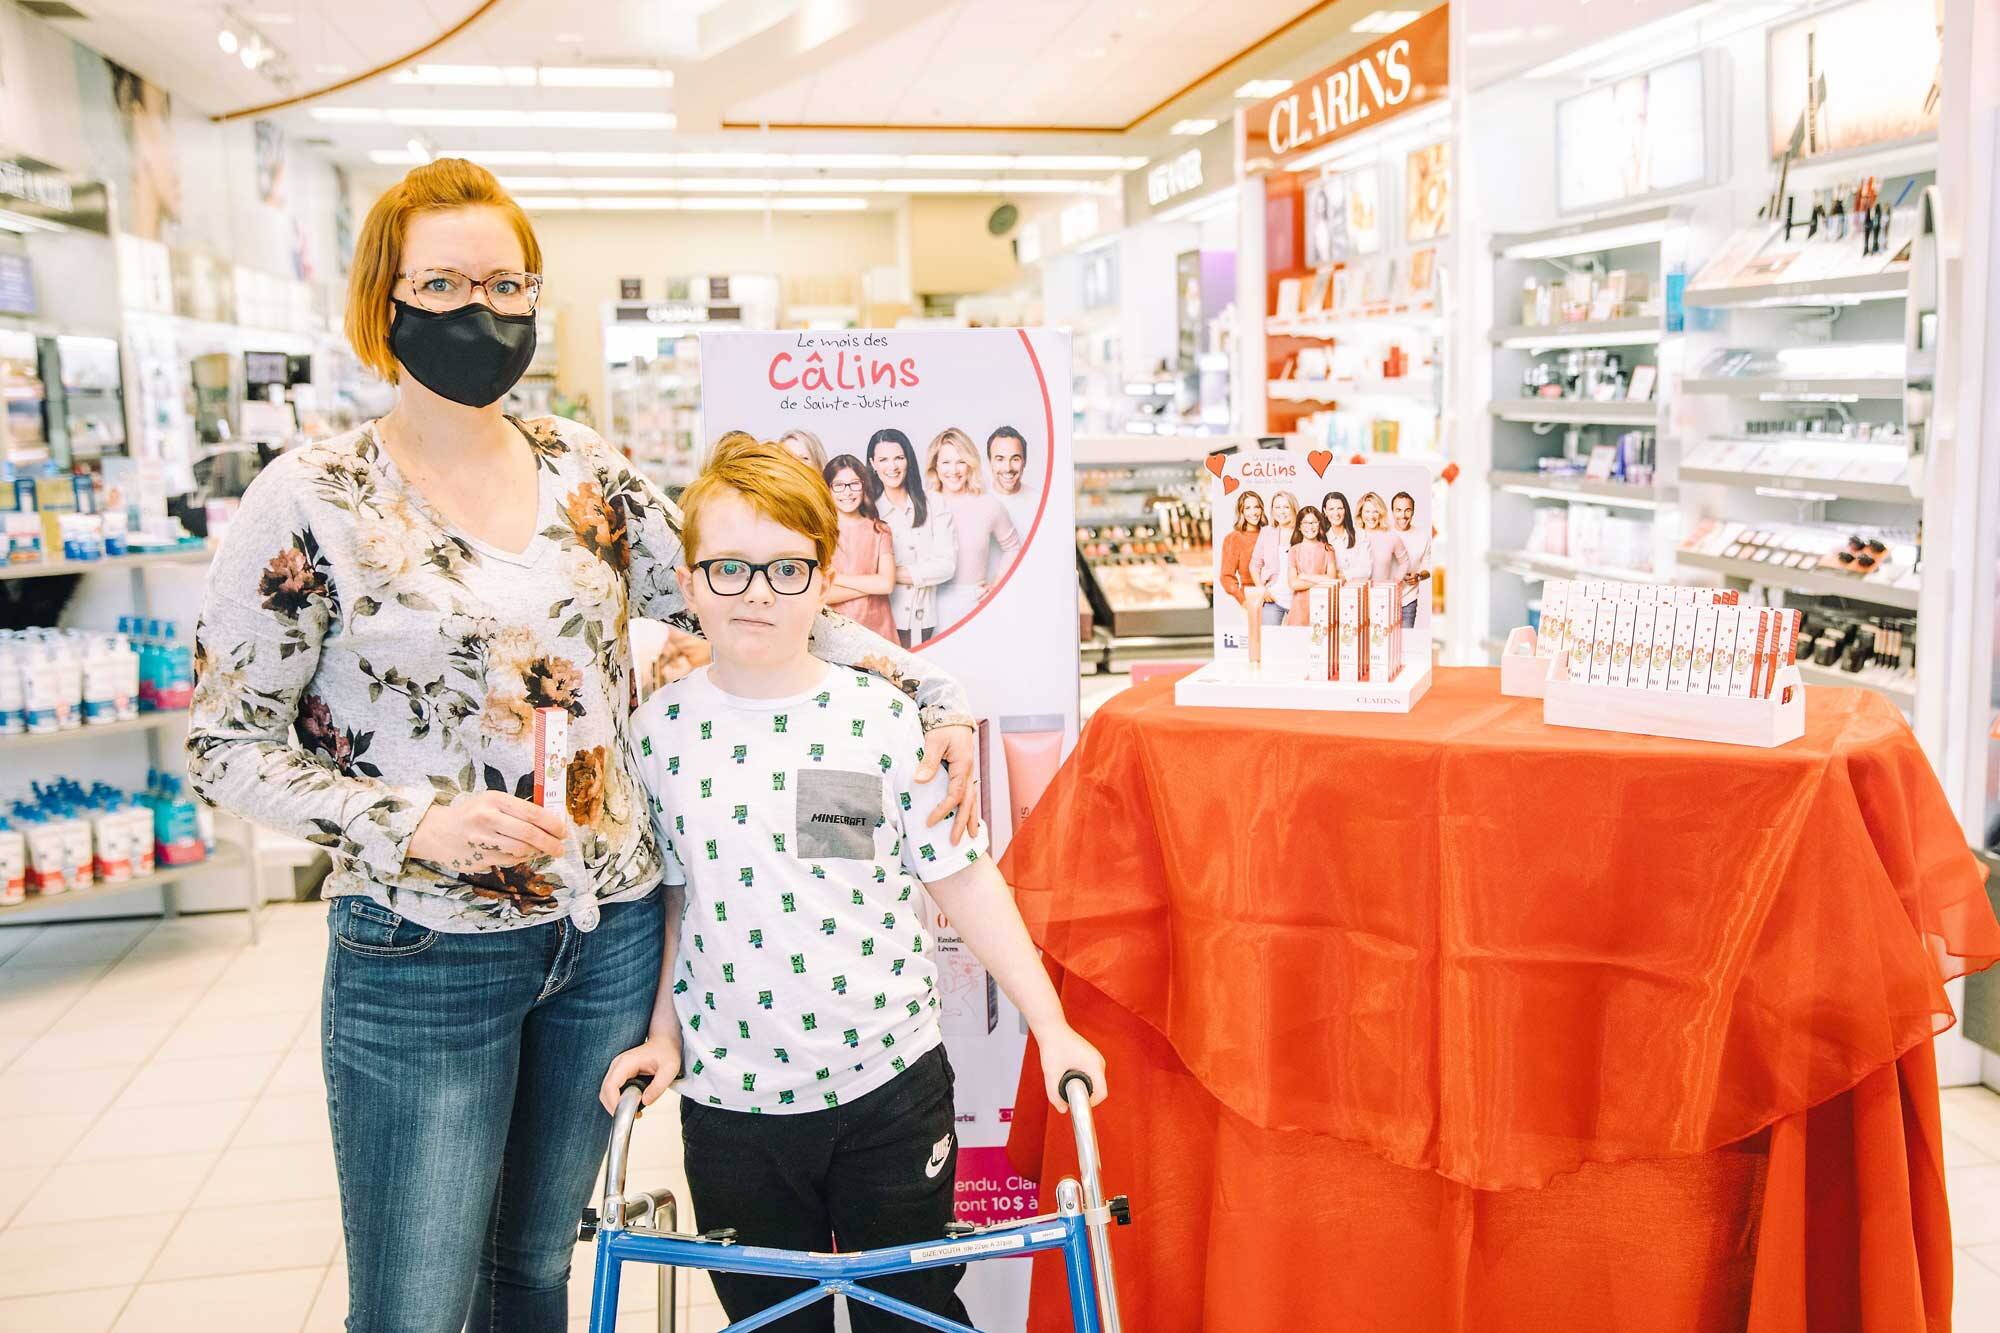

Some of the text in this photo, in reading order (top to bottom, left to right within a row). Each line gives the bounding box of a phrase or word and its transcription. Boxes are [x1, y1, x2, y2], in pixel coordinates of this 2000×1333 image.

[1268, 39, 1411, 155] CLARINS
[797, 332, 888, 348] Le mois des
[768, 351, 920, 391] Câlins
[780, 394, 911, 411] de Sainte-Justine
[1241, 461, 1297, 477] Câlins
[811, 813, 867, 826] MINECRAFT
[955, 1177, 1001, 1192] endu,
[954, 1198, 987, 1212] ront
